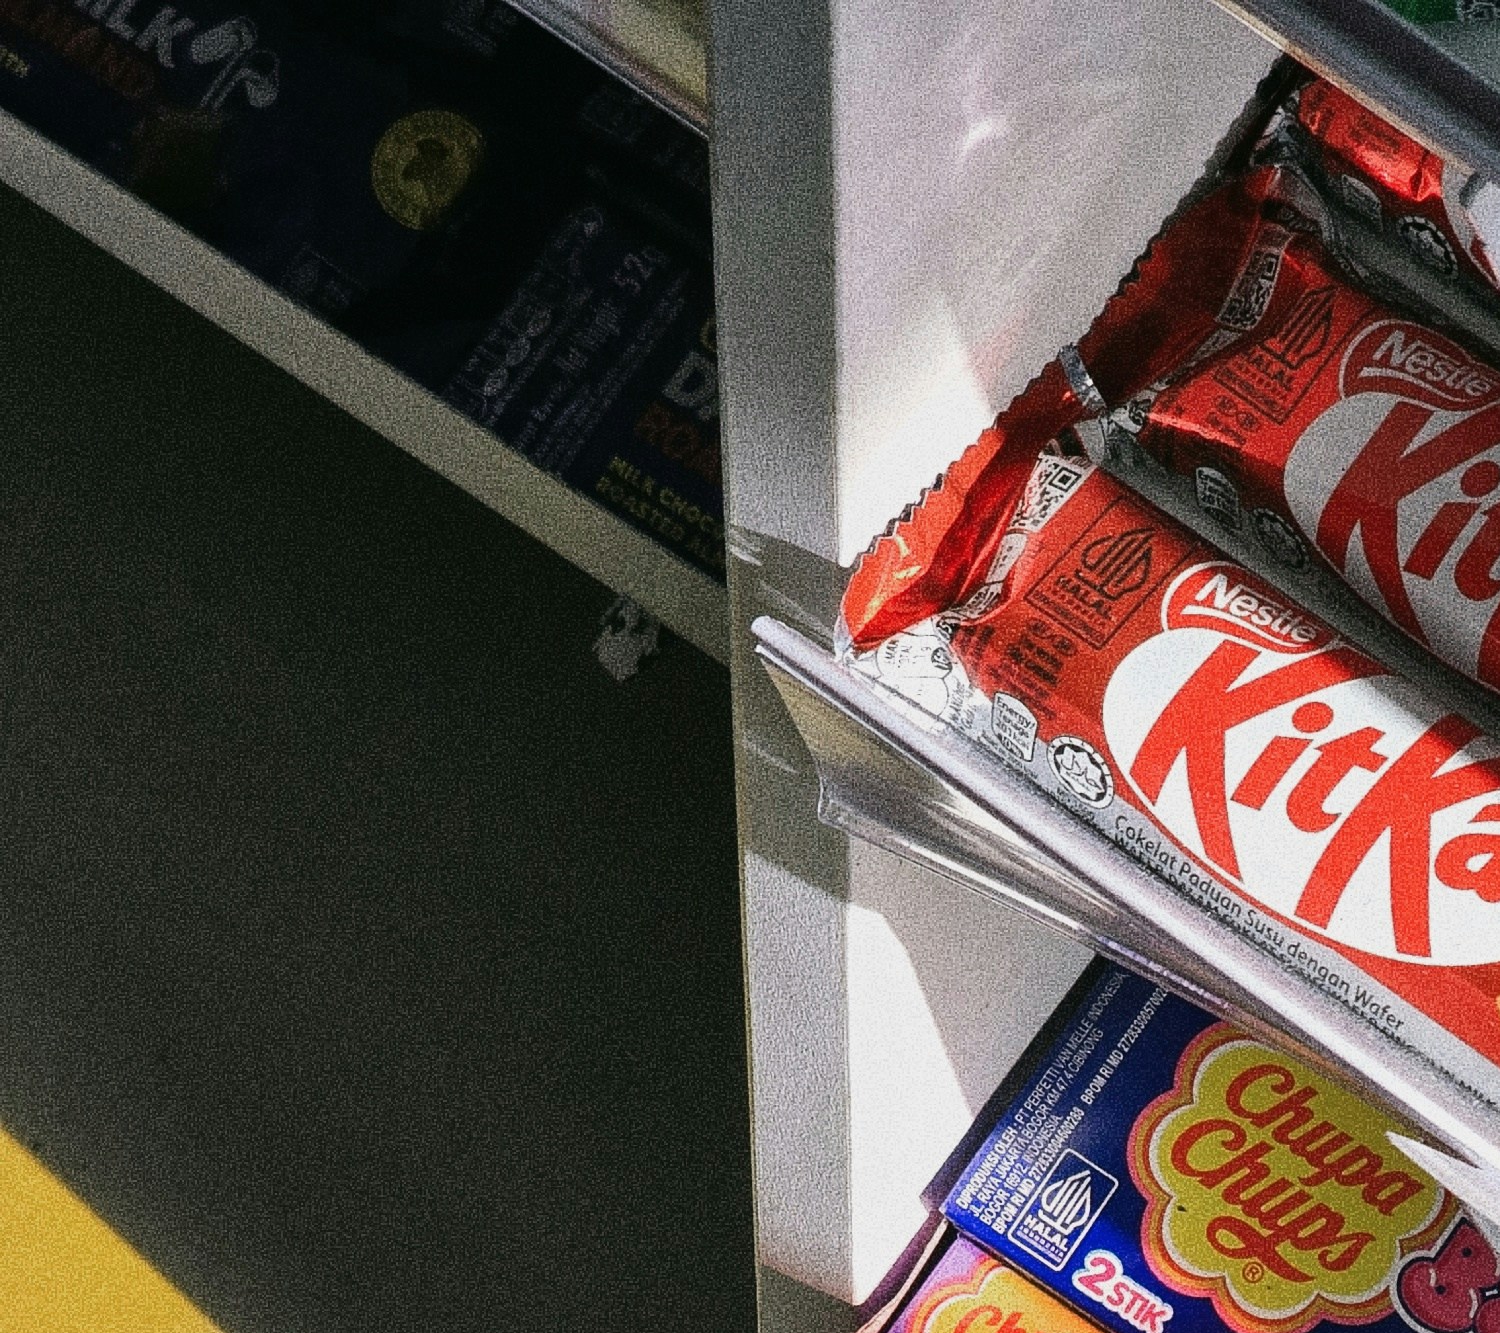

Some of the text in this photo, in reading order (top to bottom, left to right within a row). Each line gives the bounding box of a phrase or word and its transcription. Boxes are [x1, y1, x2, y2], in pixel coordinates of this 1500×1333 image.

[73, 0, 191, 67] ILK
[1108, 813, 1181, 872] Cokelat
[1175, 861, 1247, 918] Paduan
[1241, 908, 1288, 949] Susu
[1281, 937, 1355, 998] dengan
[1348, 984, 1408, 1033] Wafer
[1064, 1016, 1095, 1051] MELLE
[1051, 1045, 1076, 1071] VAN
[1021, 1065, 1062, 1113] PERFETTI
[1078, 1072, 1108, 1106] BPOM
[1012, 1107, 1032, 1126] PT
[974, 1173, 1003, 1204] RAYA
[992, 1134, 1031, 1179] JAKARTA
[1019, 1103, 1052, 1140] BOGOR
[1225, 1063, 1426, 1217] Chupa
[953, 1148, 1005, 1210] DIPRODUKSI
[977, 1187, 1012, 1226] BOGOR
[1169, 1118, 1377, 1286] Chups
[1023, 1210, 1074, 1253] HALAL
[1077, 1256, 1109, 1297] 2
